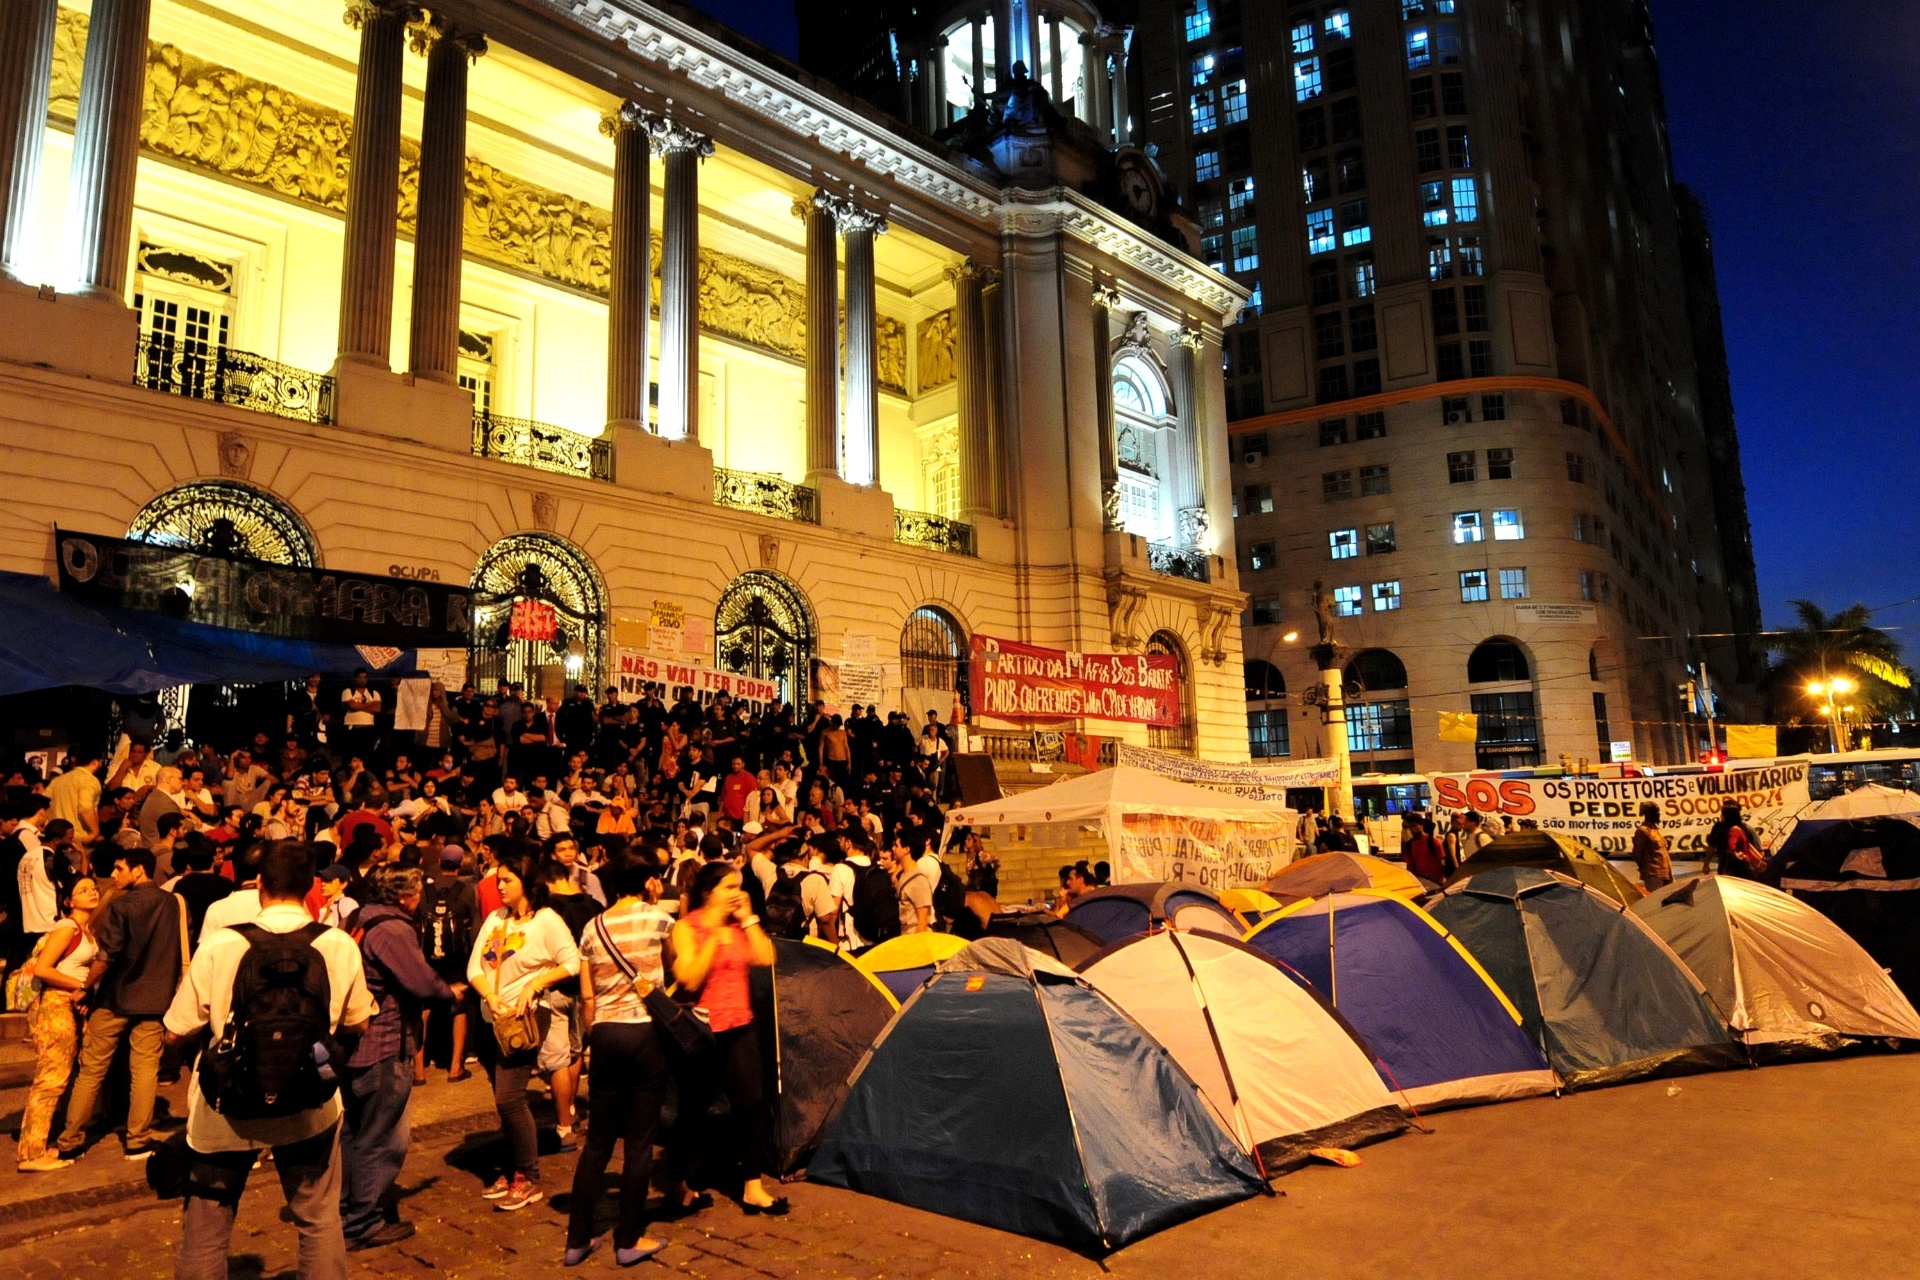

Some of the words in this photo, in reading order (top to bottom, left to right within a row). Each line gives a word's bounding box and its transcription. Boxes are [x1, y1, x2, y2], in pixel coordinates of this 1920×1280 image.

[388, 564, 441, 581] OCUPA
[659, 617, 680, 629] POVO
[985, 638, 1044, 675] PARTIDO
[1047, 658, 1065, 678] DA
[1111, 656, 1135, 685] DOS
[621, 656, 658, 679] NÃO
[666, 664, 696, 685] VAI
[703, 671, 730, 692] TER
[736, 679, 774, 700] COPA
[984, 678, 1018, 713] PMDB
[1020, 686, 1081, 714] QUEREMOS
[1218, 786, 1233, 795] NAS
[1235, 786, 1265, 795] RUAS
[1543, 782, 1571, 799] OS
[1575, 778, 1687, 800] PROTETORES
[1689, 780, 1695, 792] e
[1696, 764, 1805, 796] VOLUNTÁRIOS
[1543, 817, 1566, 829] são
[1568, 818, 1609, 830] mortos
[1612, 819, 1632, 829] nos
[1684, 816, 1694, 827] de
